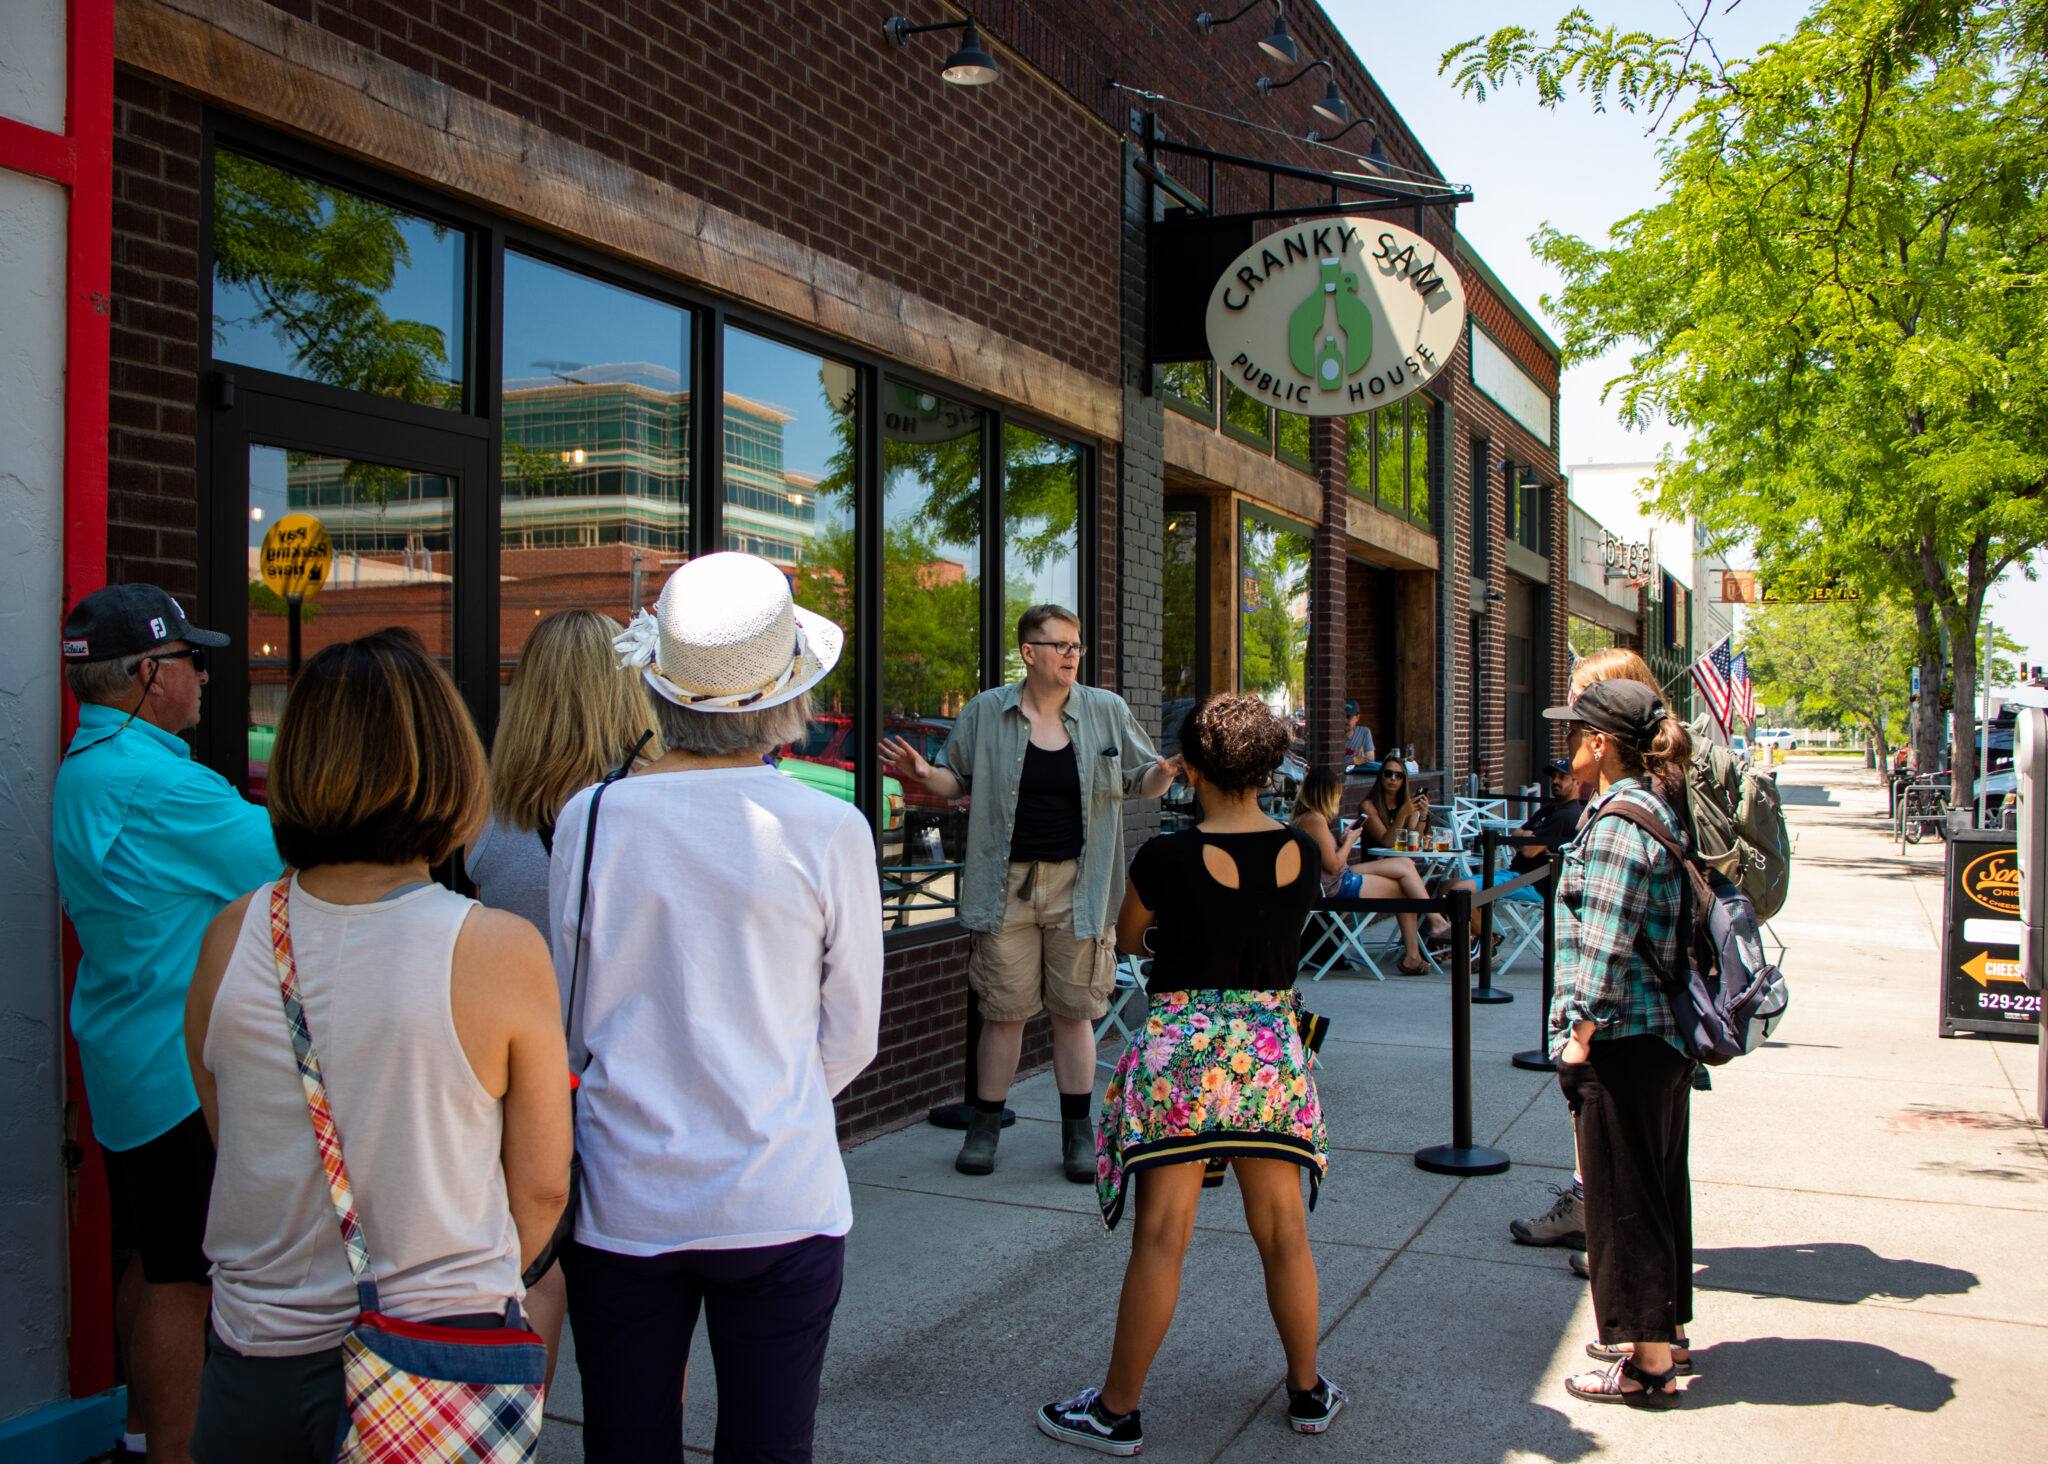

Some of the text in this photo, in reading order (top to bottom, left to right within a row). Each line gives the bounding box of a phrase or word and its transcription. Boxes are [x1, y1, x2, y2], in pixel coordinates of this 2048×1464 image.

[1223, 226, 1444, 311] CRANKY SAM
[1231, 344, 1435, 404] PUBLIC HOUSE
[151, 617, 167, 639] FJ
[1979, 858, 2019, 882] Son
[1985, 962, 2021, 977] CHEES
[1978, 993, 2042, 1012] 529-225
